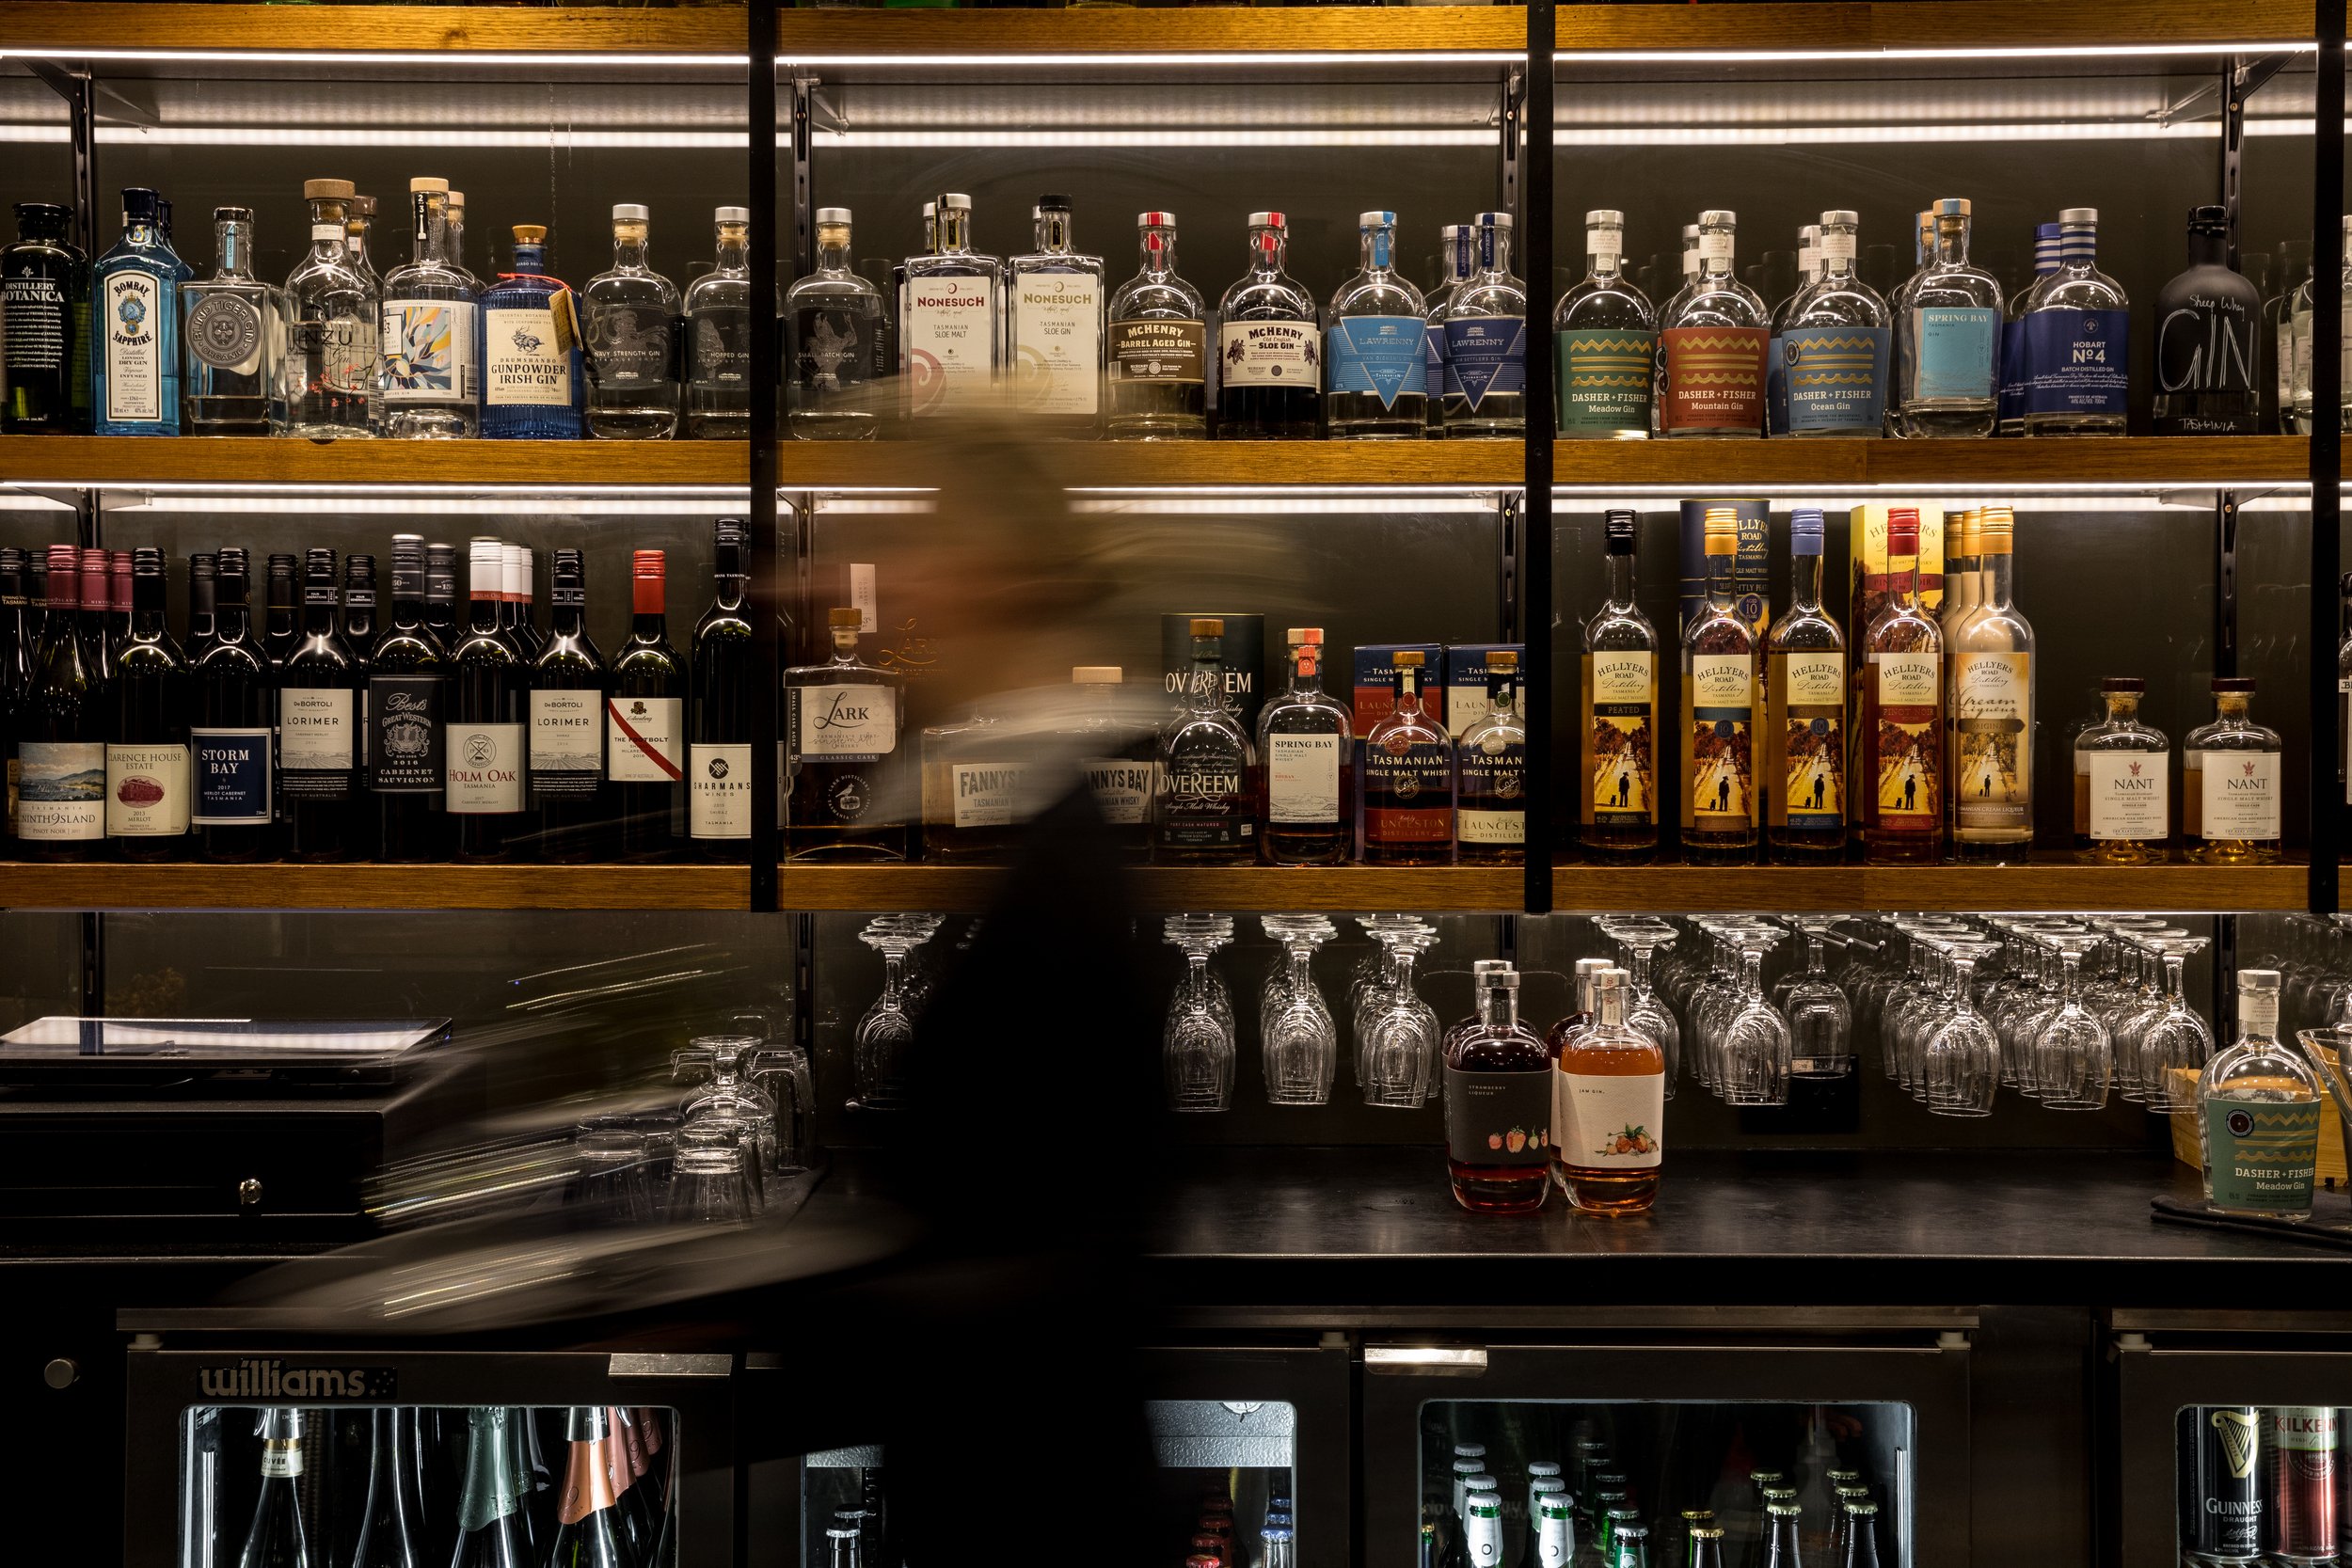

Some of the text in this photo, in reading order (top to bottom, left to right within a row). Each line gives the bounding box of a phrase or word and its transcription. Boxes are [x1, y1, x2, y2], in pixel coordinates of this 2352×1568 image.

[114, 281, 150, 297] BOMBAY
[1, 290, 65, 302] BOTANICA
[918, 297, 984, 307] NONESUCH
[1024, 293, 1091, 304] NONESUCH
[2190, 294, 2245, 322] Sheep Whey
[193, 301, 254, 343] BLIND TIGER GIN
[113, 331, 152, 346] SAPPHIRE
[1452, 339, 1505, 347] LAWRENNY
[202, 346, 245, 361] ORGANIC
[2159, 309, 2254, 392] GIN
[492, 364, 566, 375] GUNPOWDER
[500, 375, 557, 384] IRISH GIN
[1572, 393, 1647, 403] DASHER FISHER
[1679, 390, 1756, 399] DASHER FISHER
[1794, 391, 1827, 401] DASHER
[1589, 405, 1635, 413] Meadow Gin
[1692, 402, 1728, 410] Mountain
[2178, 419, 2238, 431] TASMANIA
[1746, 604, 1757, 614] 10
[1598, 662, 1649, 677] HELLYERS
[1698, 666, 1749, 681] HELLYERS
[1792, 664, 1841, 679] HELLYERS
[1884, 664, 1935, 679] HELLYERS
[1968, 661, 2013, 674] HELLYERS
[1602, 678, 1645, 693] Distillery
[1972, 674, 2008, 687] Distillery
[1702, 682, 1745, 697] Distillery
[1797, 680, 1838, 695] Distillery
[1888, 680, 1931, 695] Distillery
[385, 693, 428, 711] Best's
[813, 691, 869, 729] LARK
[382, 712, 431, 728] GREAT WESTERN
[108, 753, 181, 762] CLARENCE HOUSE
[202, 749, 249, 760] STORM
[1373, 755, 1443, 765] TASMANIAN
[211, 763, 239, 774] BAY
[449, 769, 516, 782] HOLM OAK
[1128, 768, 1150, 794] BAY
[841, 775, 870, 791] DISTILLERY
[960, 770, 1015, 797] FANNYS
[1160, 773, 1238, 795] OVEREEM
[2115, 779, 2154, 789] NANT
[2228, 779, 2267, 789] NANT
[974, 798, 1010, 807] TASMANIAN
[1120, 796, 1139, 806] WHISKY
[828, 800, 849, 819] TASMANIA
[1165, 803, 1183, 814] Single
[1204, 802, 1230, 815] Whisky
[2235, 1167, 2315, 1179] DASHER FISHER
[2256, 1181, 2305, 1191] Meadow Gin
[200, 1360, 366, 1397] williams
[2274, 1415, 2337, 1433] KILKENN
[2206, 1498, 2262, 1515] GUINNESS
